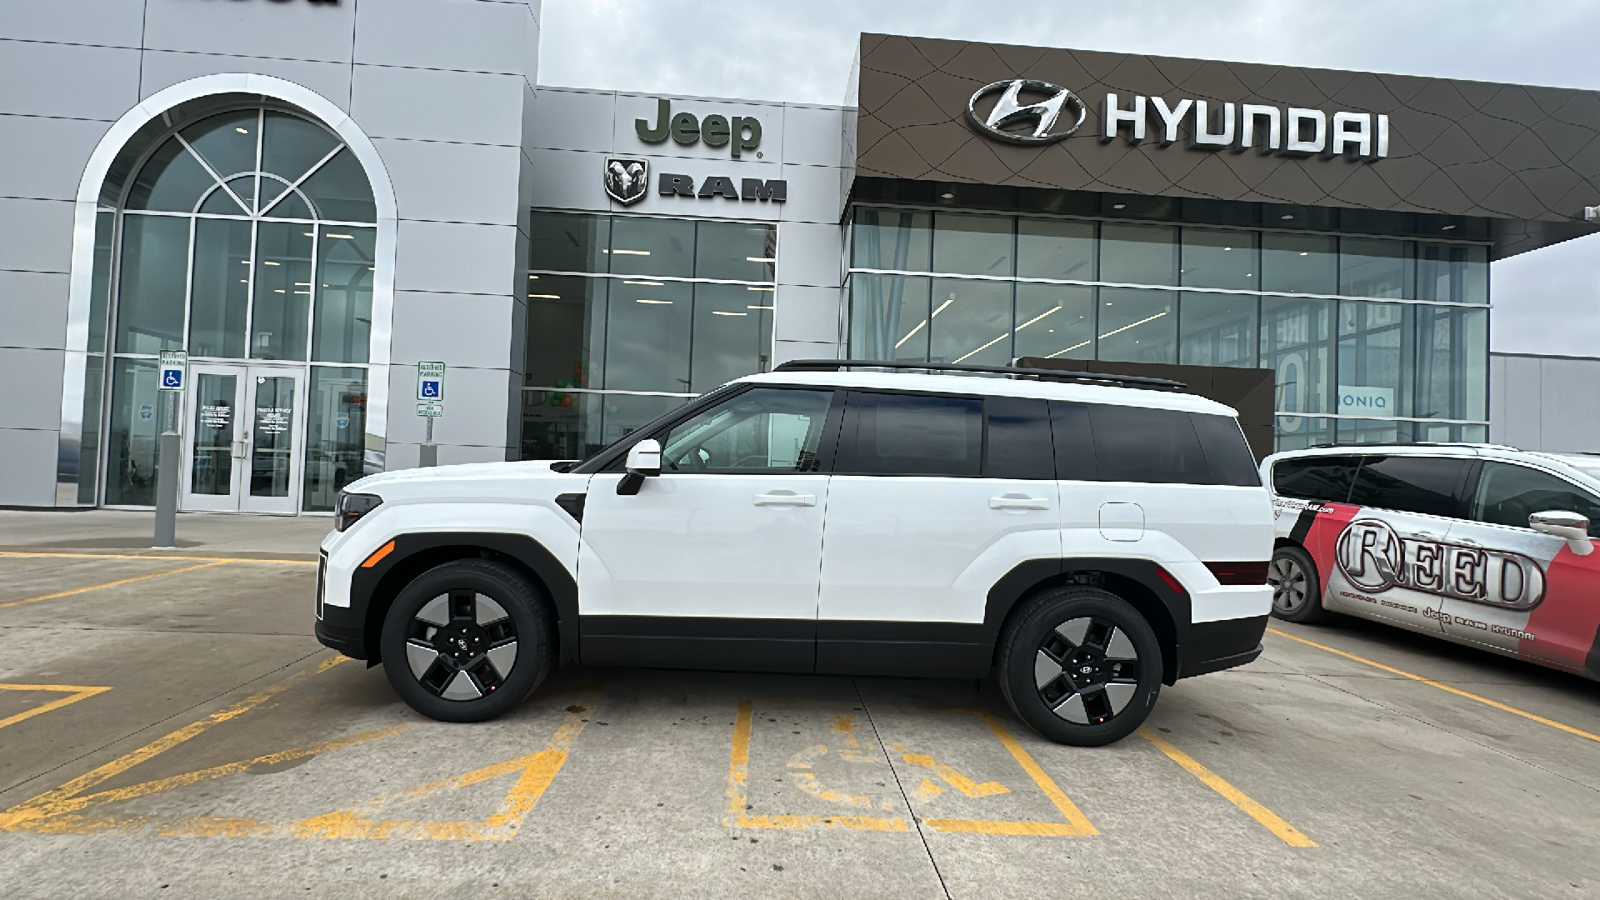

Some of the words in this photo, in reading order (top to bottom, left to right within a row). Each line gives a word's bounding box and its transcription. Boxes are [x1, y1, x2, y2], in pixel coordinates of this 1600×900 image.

[635, 98, 763, 158] Jeep
[1104, 93, 1389, 158] HYUNDAI
[659, 173, 787, 203] RAM
[1338, 520, 1546, 609] REED
[1423, 607, 1452, 625] Jeep
[1455, 616, 1487, 631] RAM
[1491, 625, 1535, 641] HYUNDAI
